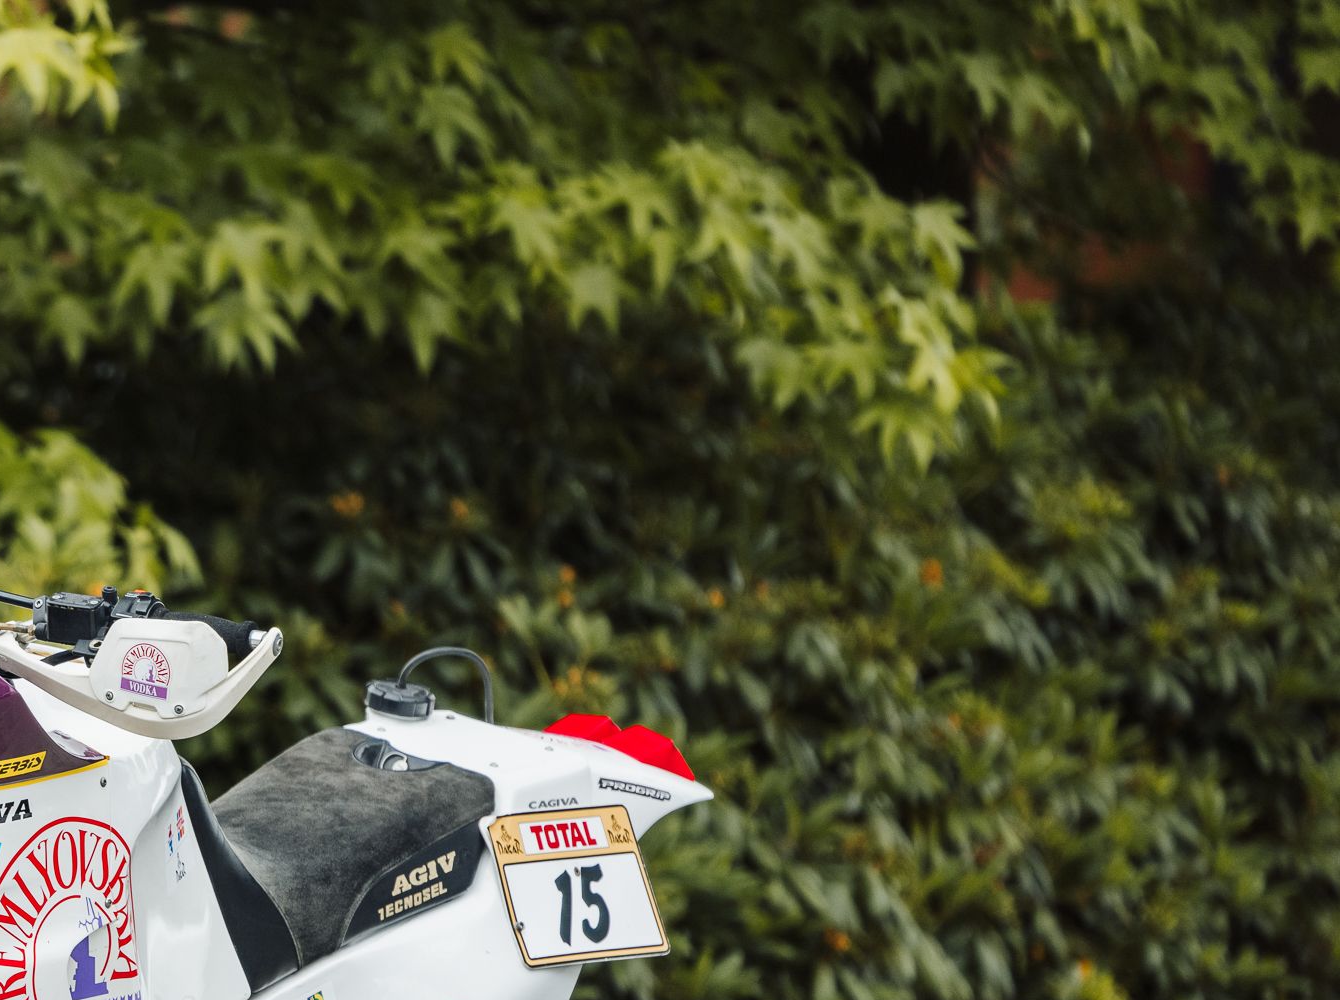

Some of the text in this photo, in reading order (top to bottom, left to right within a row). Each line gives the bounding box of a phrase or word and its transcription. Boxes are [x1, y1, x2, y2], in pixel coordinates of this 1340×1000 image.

[129, 680, 158, 697] VODKA
[598, 777, 672, 802] PROGRIP
[528, 797, 579, 810] CAGIVA
[529, 821, 598, 851] TOTAL
[606, 827, 634, 845] DAKAR
[495, 838, 524, 856] DAKAR
[554, 862, 611, 947] 15
